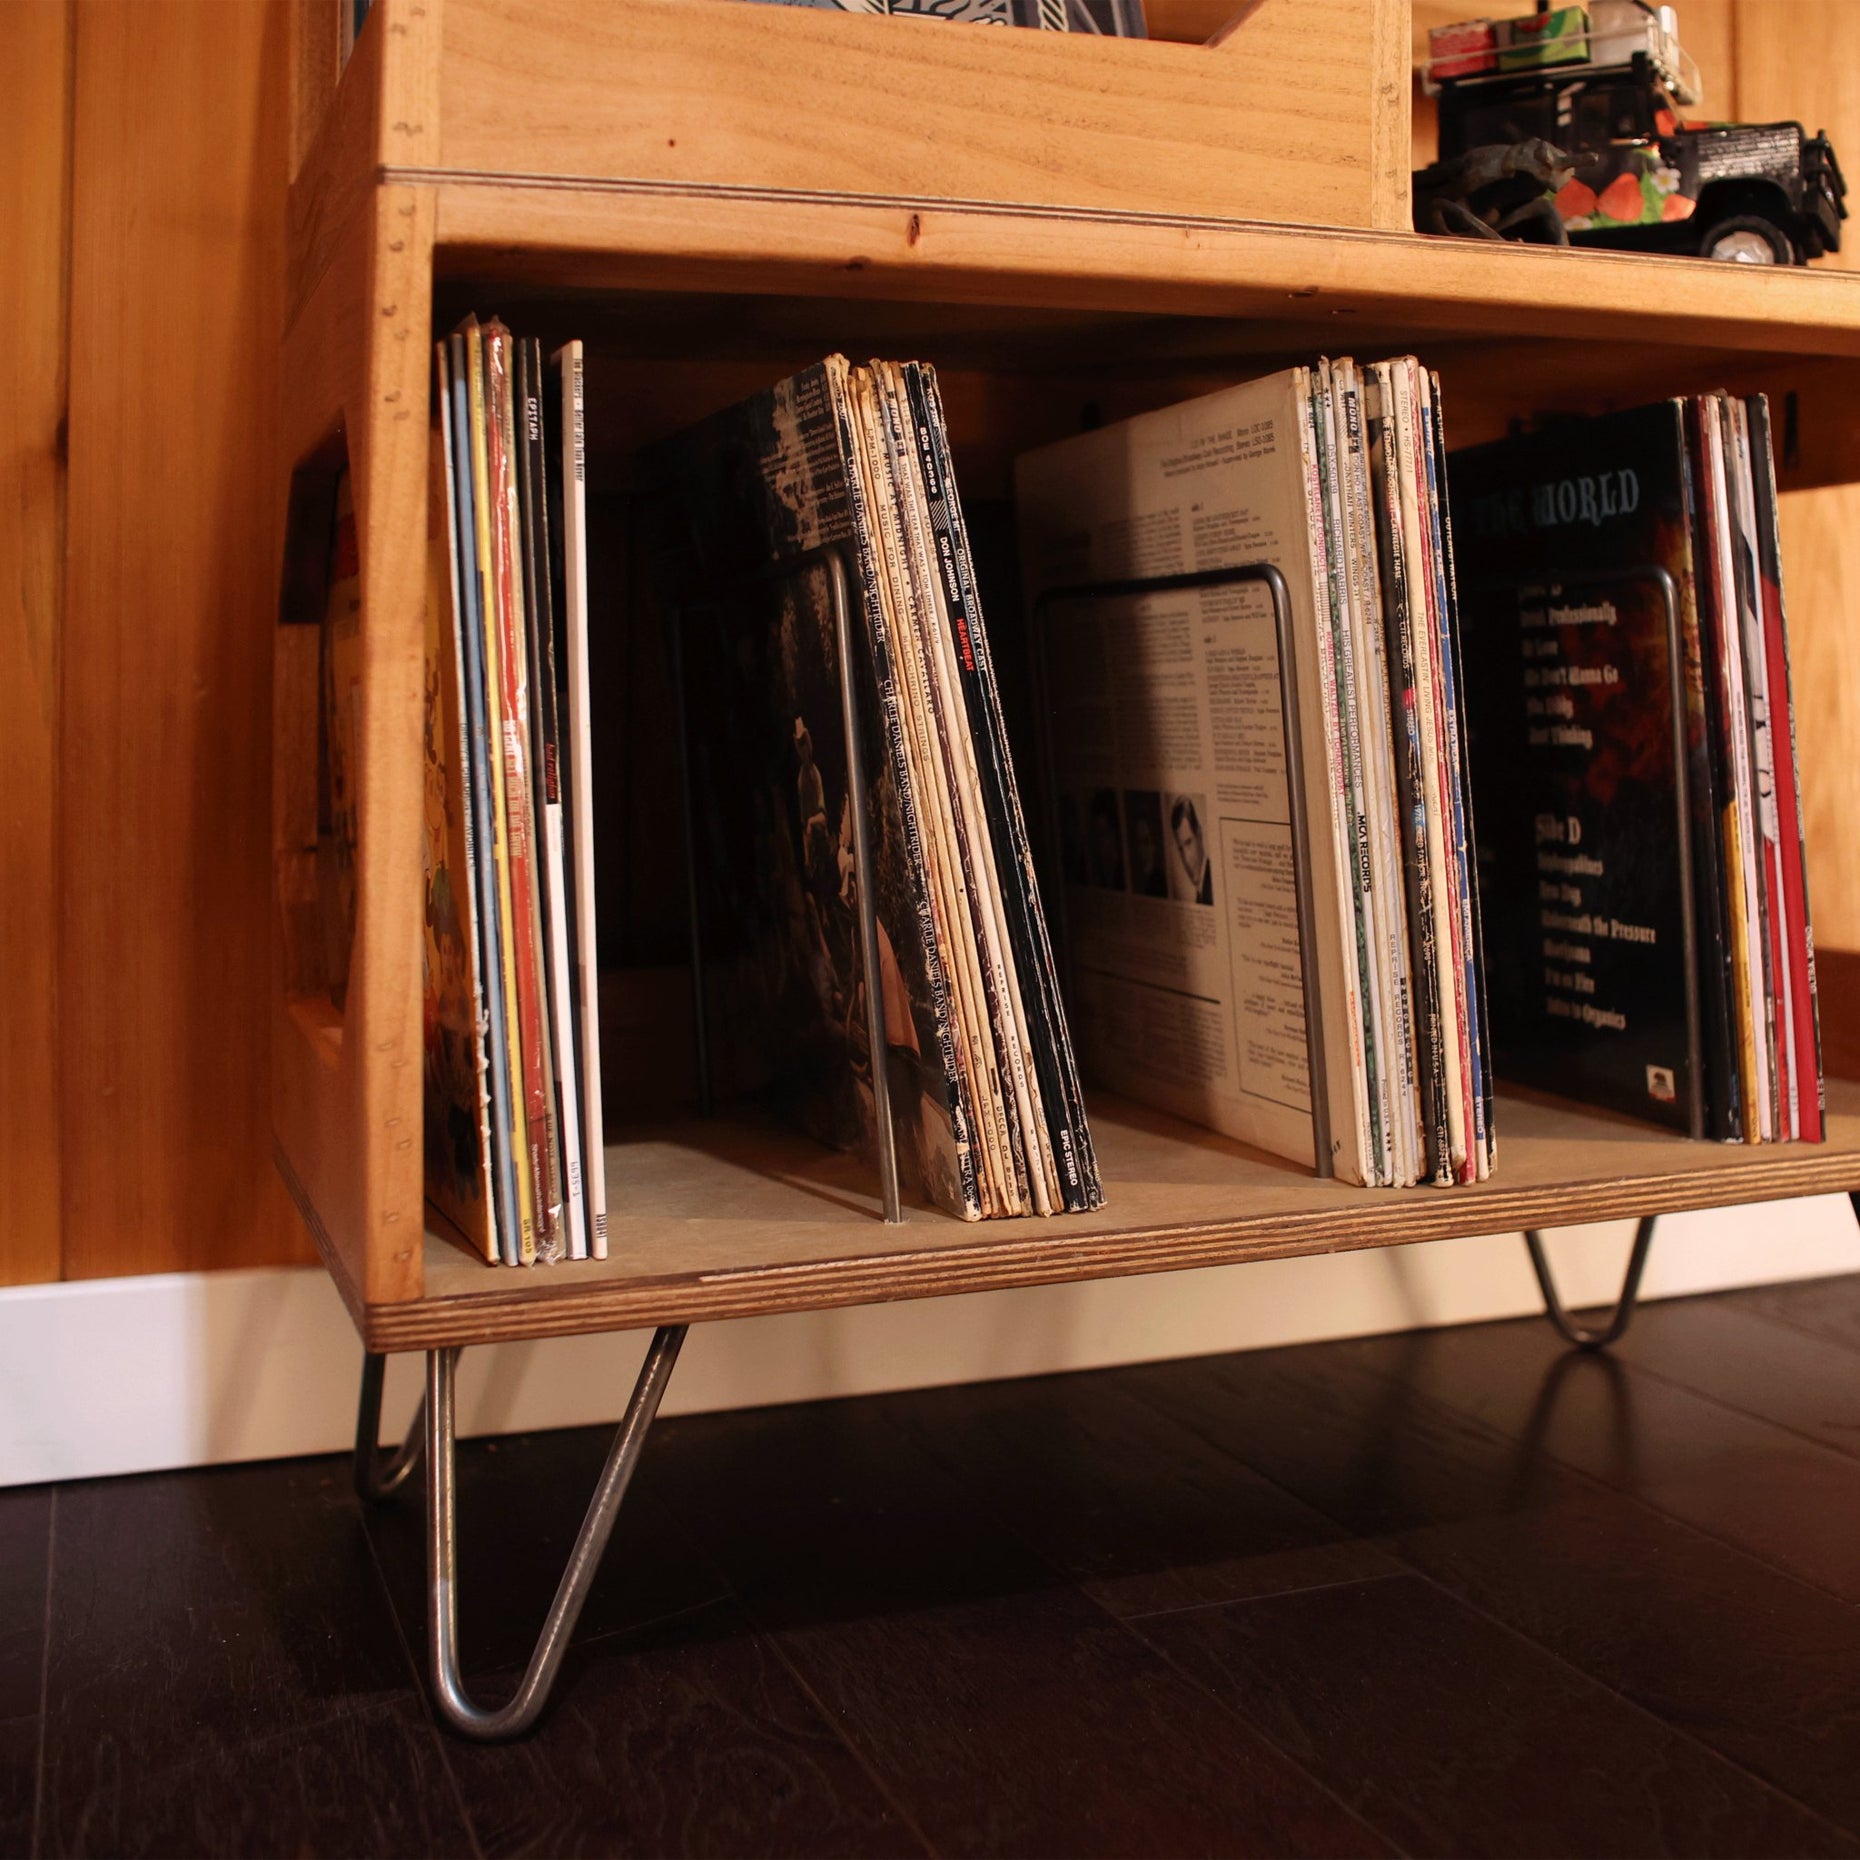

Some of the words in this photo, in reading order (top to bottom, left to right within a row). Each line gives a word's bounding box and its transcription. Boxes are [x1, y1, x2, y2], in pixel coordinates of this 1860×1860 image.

[527, 397, 539, 440] EPITAPH
[887, 396, 902, 435] MONO
[1347, 397, 1358, 431] MONO
[1399, 389, 1410, 423] STEREO
[919, 425, 930, 450] BOE
[846, 456, 862, 500] CHARLIE
[904, 481, 912, 497] WAS
[1327, 444, 1337, 494] DSX-50139
[882, 451, 894, 487] MUSIC
[893, 512, 909, 571] MIDNIGHT
[907, 499, 915, 512] THE
[1311, 463, 1323, 522] KOSTELANETZ
[1533, 468, 1640, 528] WORLD
[853, 501, 869, 546] DANIELS
[910, 513, 918, 530] YEAR
[914, 532, 922, 549] THAT
[1333, 518, 1343, 563] RICHARD
[917, 551, 925, 567] WAS
[939, 536, 950, 556] DON
[1316, 525, 1327, 573] CONDUCTS
[921, 574, 929, 589] TOM
[943, 557, 960, 602] JOHNSON
[1337, 566, 1347, 604] HARRIS
[1350, 558, 1359, 586] WINGS
[859, 547, 886, 643] BAND/NIGHTRIDER
[866, 428, 881, 480] LPM-1000
[879, 504, 890, 538] MUSIC
[886, 546, 896, 568] FOR
[915, 715, 930, 761] STRINGS
[956, 547, 972, 591] ORIGINAL
[965, 593, 982, 644] BROADWAY
[975, 647, 988, 672] CAST
[1342, 629, 1351, 647] HIS
[1417, 611, 1425, 627] THE
[955, 617, 975, 672] HEARTBEAT
[1325, 631, 1335, 675] ROMANTIC
[1418, 630, 1429, 682] EVERLASTIN'
[1344, 649, 1355, 700] GREATEST
[883, 678, 899, 723] CHARLIE
[1328, 679, 1338, 718] WALTZES
[1422, 686, 1431, 714] LIVING
[1332, 721, 1339, 732] BY
[1406, 709, 1415, 736] STEREO
[1424, 716, 1433, 743] JESUS
[544, 742, 555, 761] bad
[890, 724, 906, 767] DANIELS
[1348, 703, 1362, 788] PERFORMANCES
[544, 762, 558, 798] religion
[1333, 736, 1345, 796] TCHAIKOVSKY
[897, 769, 921, 864] BAND/NIGHTRIDER
[1568, 816, 1582, 846] D
[1359, 841, 1371, 892] RECORDS
[1463, 917, 1473, 960] AMERICA
[926, 946, 942, 987] DANIELS
[1389, 933, 1399, 986] REPRISE
[1394, 994, 1403, 1045] RECORDS
[1474, 1095, 1483, 1133] STEREO
[1059, 1128, 1071, 1150] EPIC
[1064, 1150, 1078, 1186] STEREO
